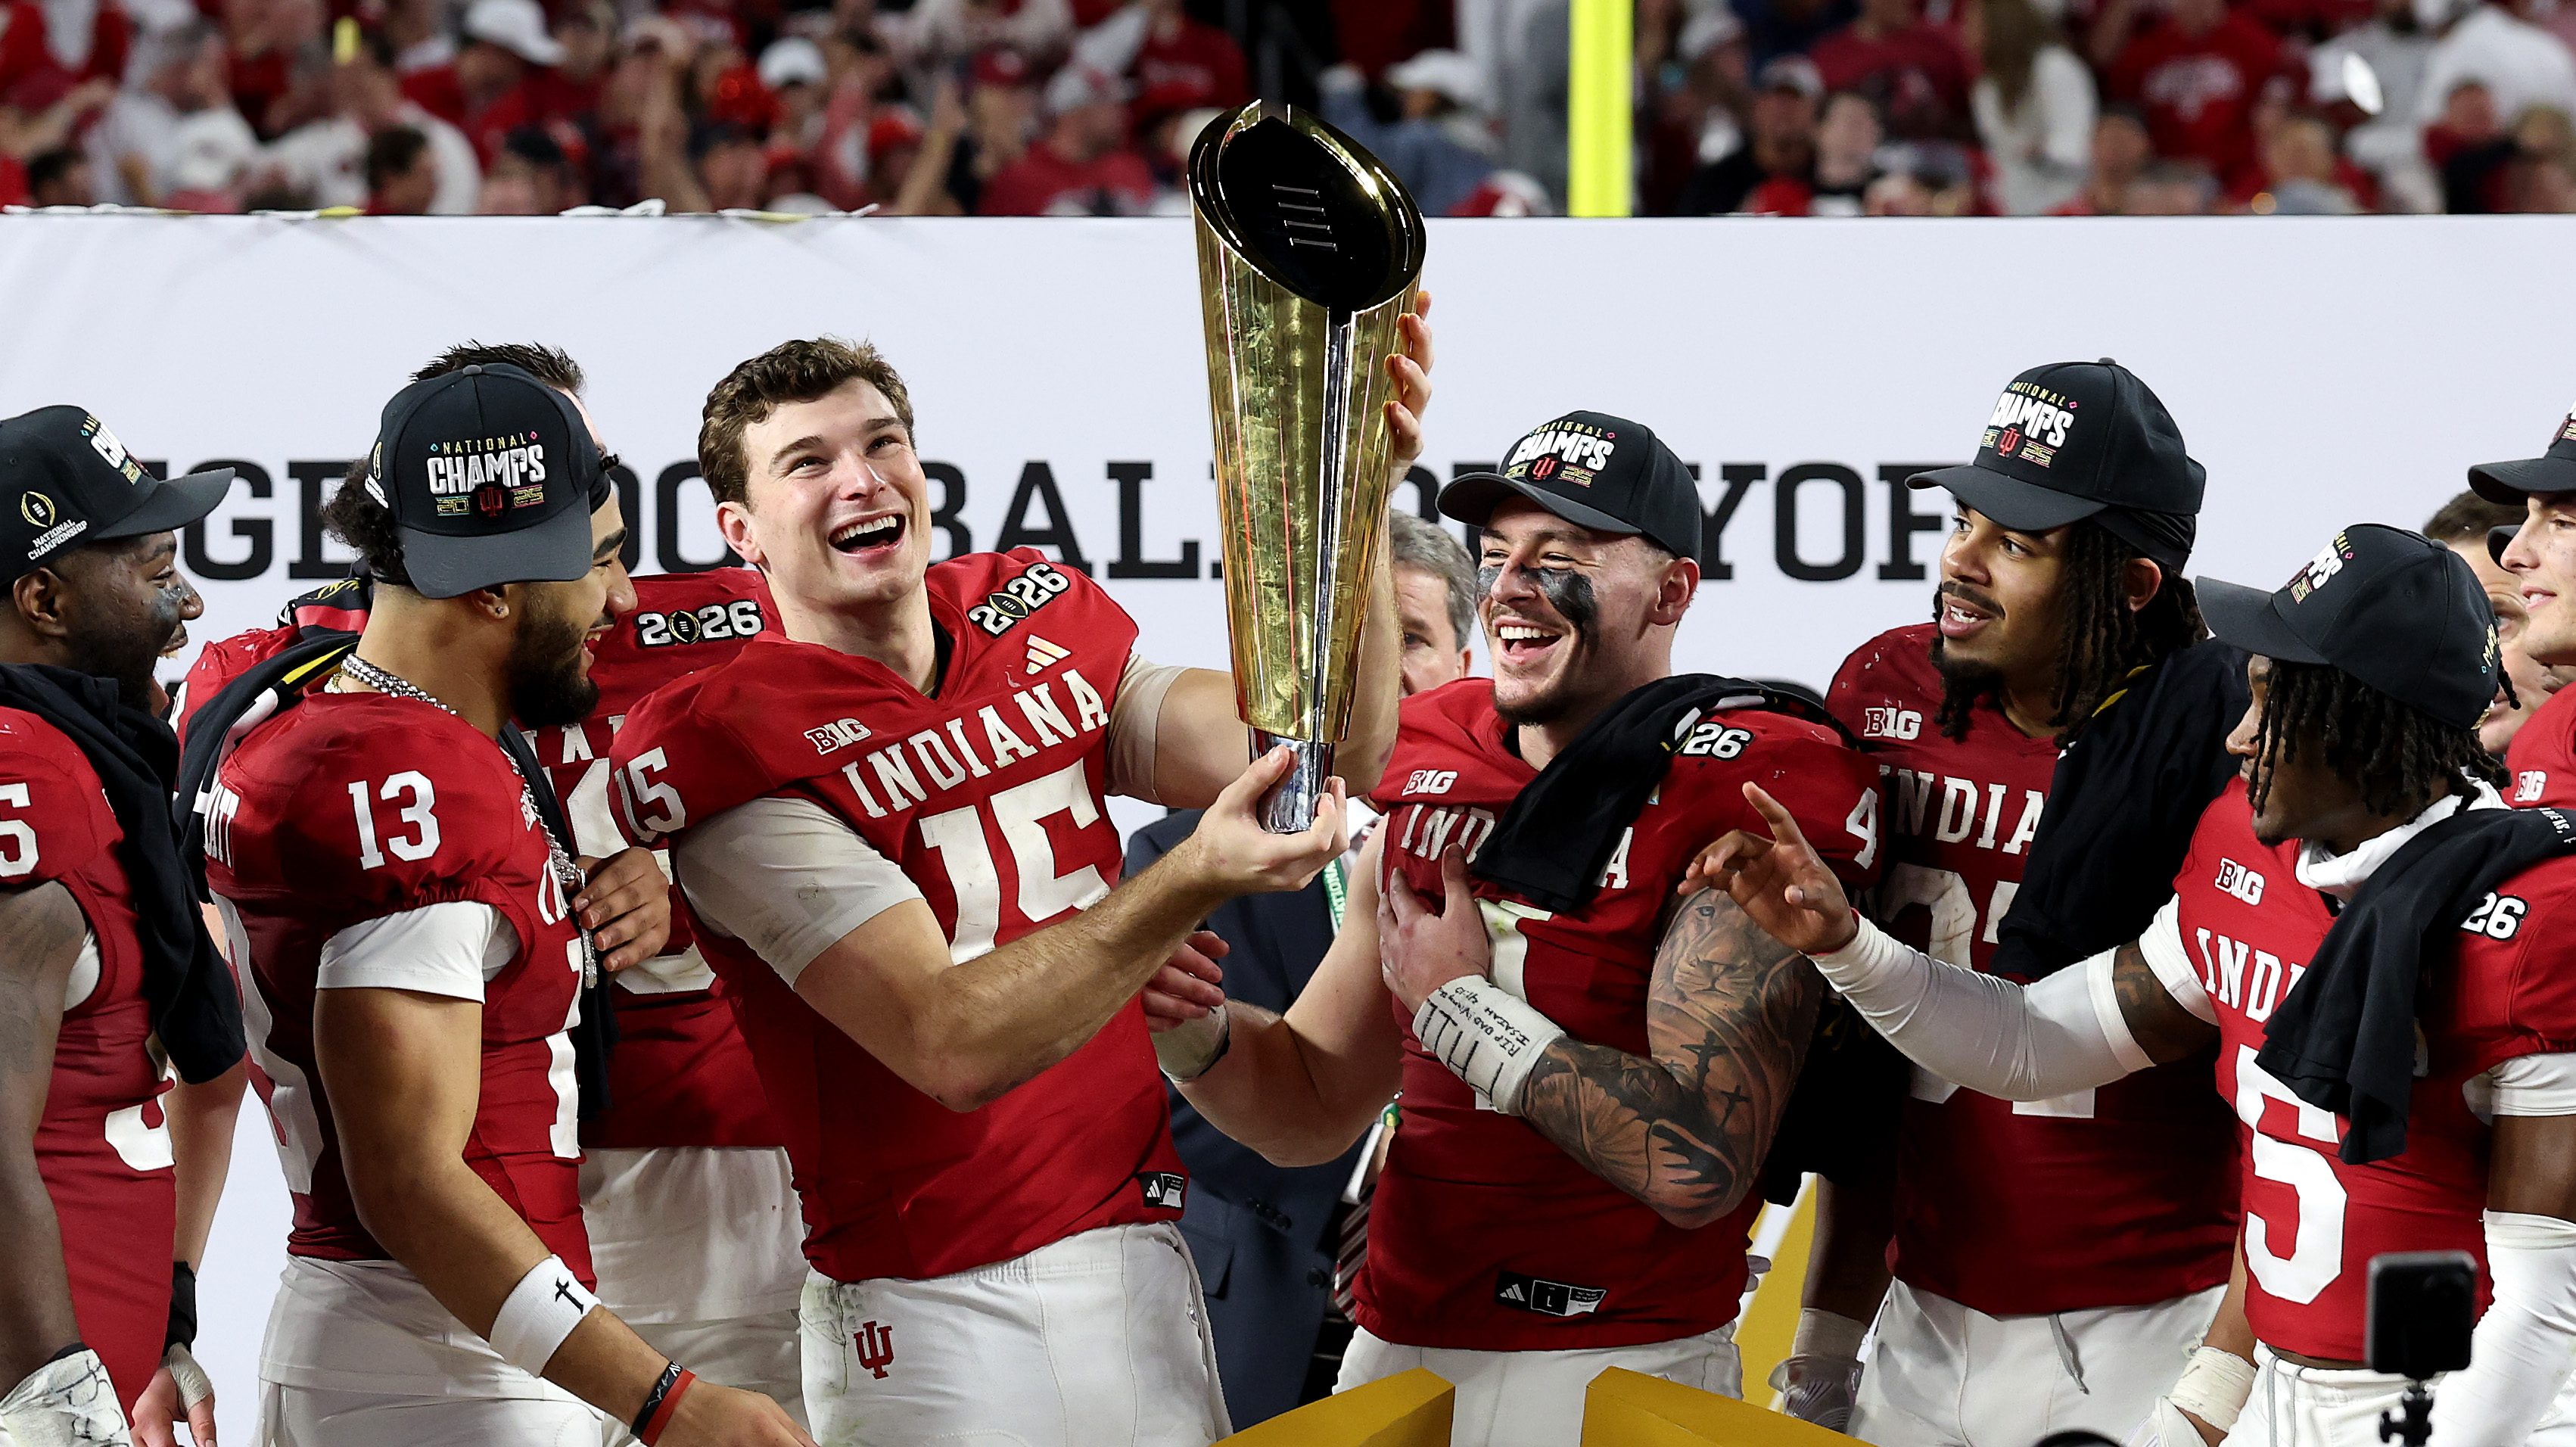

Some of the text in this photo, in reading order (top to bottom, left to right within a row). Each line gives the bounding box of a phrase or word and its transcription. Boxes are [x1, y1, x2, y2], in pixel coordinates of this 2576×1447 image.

[426, 443, 546, 495] CHAMPS
[443, 432, 527, 455] NATIONAL
[27, 520, 88, 561] CHAMPIONSHIP
[33, 518, 76, 548] NATIONAL
[638, 600, 763, 646] 2026
[968, 562, 1069, 636] 2026
[842, 668, 1109, 819] INDIANA
[347, 769, 443, 871] 13
[614, 745, 686, 843] 15
[919, 757, 1111, 966] 15
[1473, 1016, 1495, 1036] DAD
[1485, 1006, 1530, 1047] ISAIAH
[2235, 1043, 2347, 1305] 5
